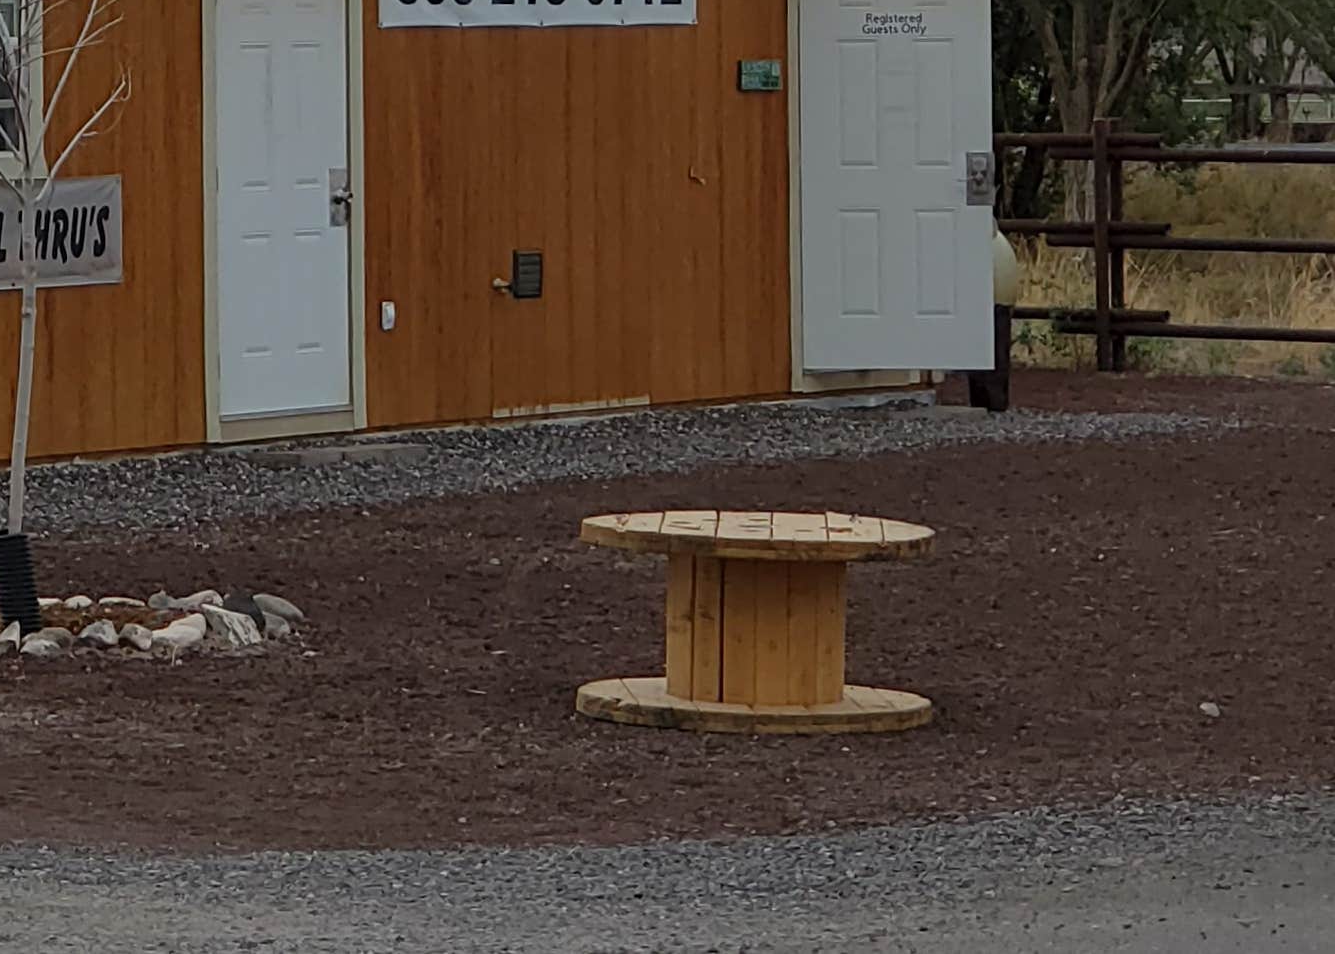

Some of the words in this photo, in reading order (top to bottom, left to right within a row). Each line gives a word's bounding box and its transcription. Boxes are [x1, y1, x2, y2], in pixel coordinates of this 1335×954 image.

[866, 13, 922, 24] Registered
[862, 24, 898, 34] Guests
[901, 23, 927, 35] Only
